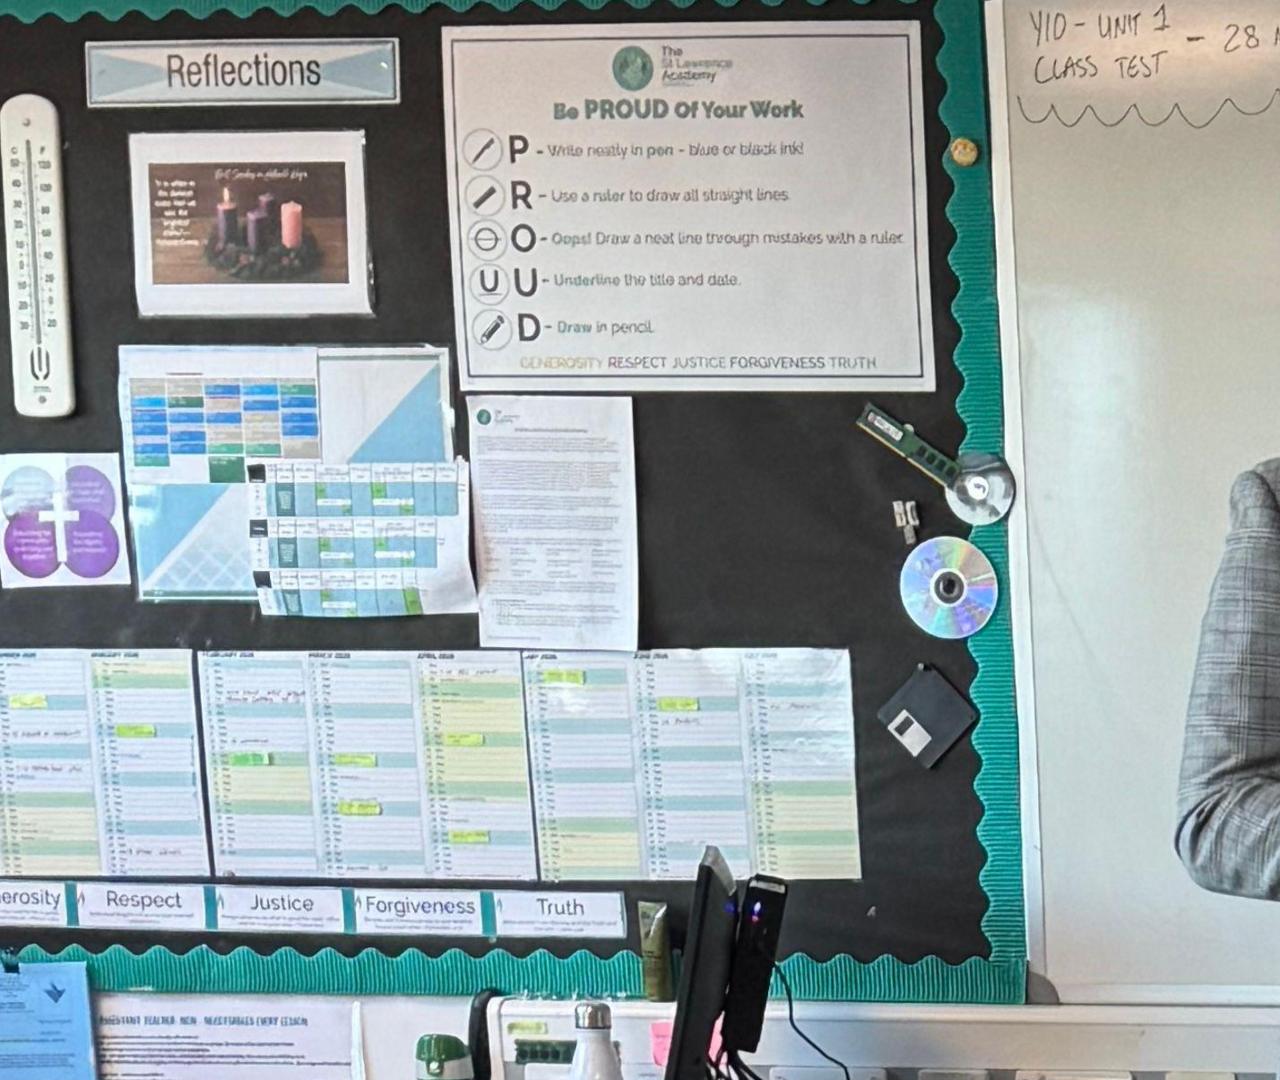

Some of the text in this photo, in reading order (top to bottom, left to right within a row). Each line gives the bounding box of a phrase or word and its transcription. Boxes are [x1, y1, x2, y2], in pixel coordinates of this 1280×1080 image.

[1027, 8, 1070, 50] Y10
[1097, 8, 1142, 42] UNIT
[1222, 22, 1261, 54] 28
[661, 44, 685, 58] The
[166, 54, 322, 88] Reflections
[661, 70, 717, 84] Academy
[1033, 49, 1169, 86] CLASS TEST
[553, 98, 805, 121] Be PROUD Of Your Work
[509, 135, 529, 164] P
[646, 147, 674, 161] pen
[689, 144, 719, 157] blue
[511, 180, 532, 209] R
[551, 189, 578, 203] Use
[581, 193, 590, 203] a
[629, 191, 642, 202] to
[646, 188, 680, 202] draw
[683, 188, 699, 202] all
[702, 188, 753, 205] straight
[511, 224, 536, 252] O
[596, 231, 630, 245] Draw
[633, 235, 642, 245] a
[644, 231, 674, 244] neat
[678, 231, 703, 244] line
[706, 231, 759, 248] through
[763, 231, 823, 244] mistakes
[826, 230, 855, 244] with
[858, 235, 867, 244] a
[514, 268, 537, 297] U
[554, 274, 621, 288] Underline
[624, 273, 647, 287] the
[678, 273, 704, 287] and
[518, 313, 541, 341] D
[557, 320, 593, 334] Draw
[596, 320, 608, 333] in
[607, 356, 667, 369] RESPECT
[672, 356, 726, 369] JUSTICE
[729, 356, 826, 369] FORGIVENESS
[829, 356, 877, 369] TRUTH
[0, 889, 585, 917] erosity Respect Justice Forgiveness Truth
